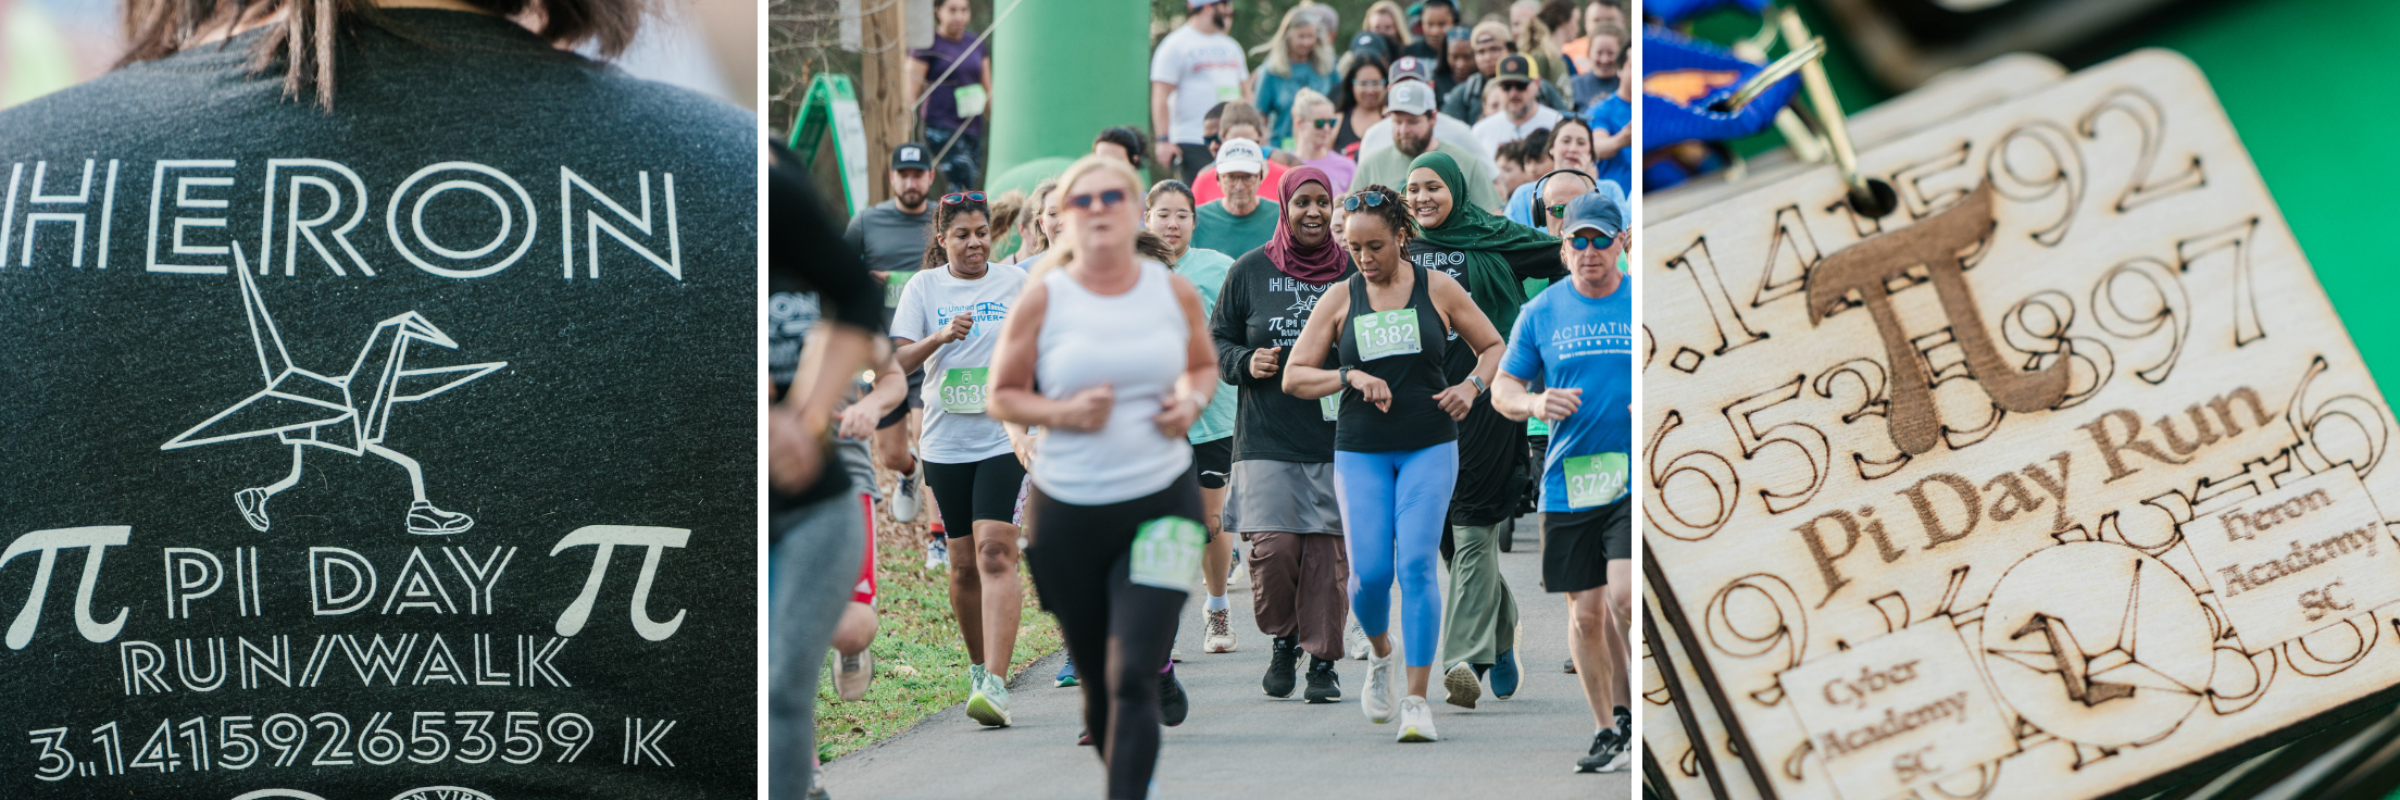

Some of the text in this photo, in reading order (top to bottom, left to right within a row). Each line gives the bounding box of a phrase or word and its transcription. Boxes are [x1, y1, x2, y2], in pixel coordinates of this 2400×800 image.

[0, 158, 684, 281] HERON
[1411, 252, 1465, 267] HERO
[1361, 324, 1416, 349] 1382
[1571, 470, 1624, 497] 3724
[1790, 503, 1906, 608] Pi
[1895, 451, 2072, 552] Day
[2075, 386, 2281, 484] Run
[164, 547, 261, 619] PI
[310, 546, 518, 616] DAY
[2217, 521, 2378, 597] Academy
[2298, 577, 2355, 621] SC
[120, 635, 573, 697] RUN/WALK
[1822, 659, 1922, 710] Cyber
[28, 711, 678, 782] 3.14159265359 K
[1818, 691, 1969, 761] Academy
[1892, 745, 1944, 783] SC
